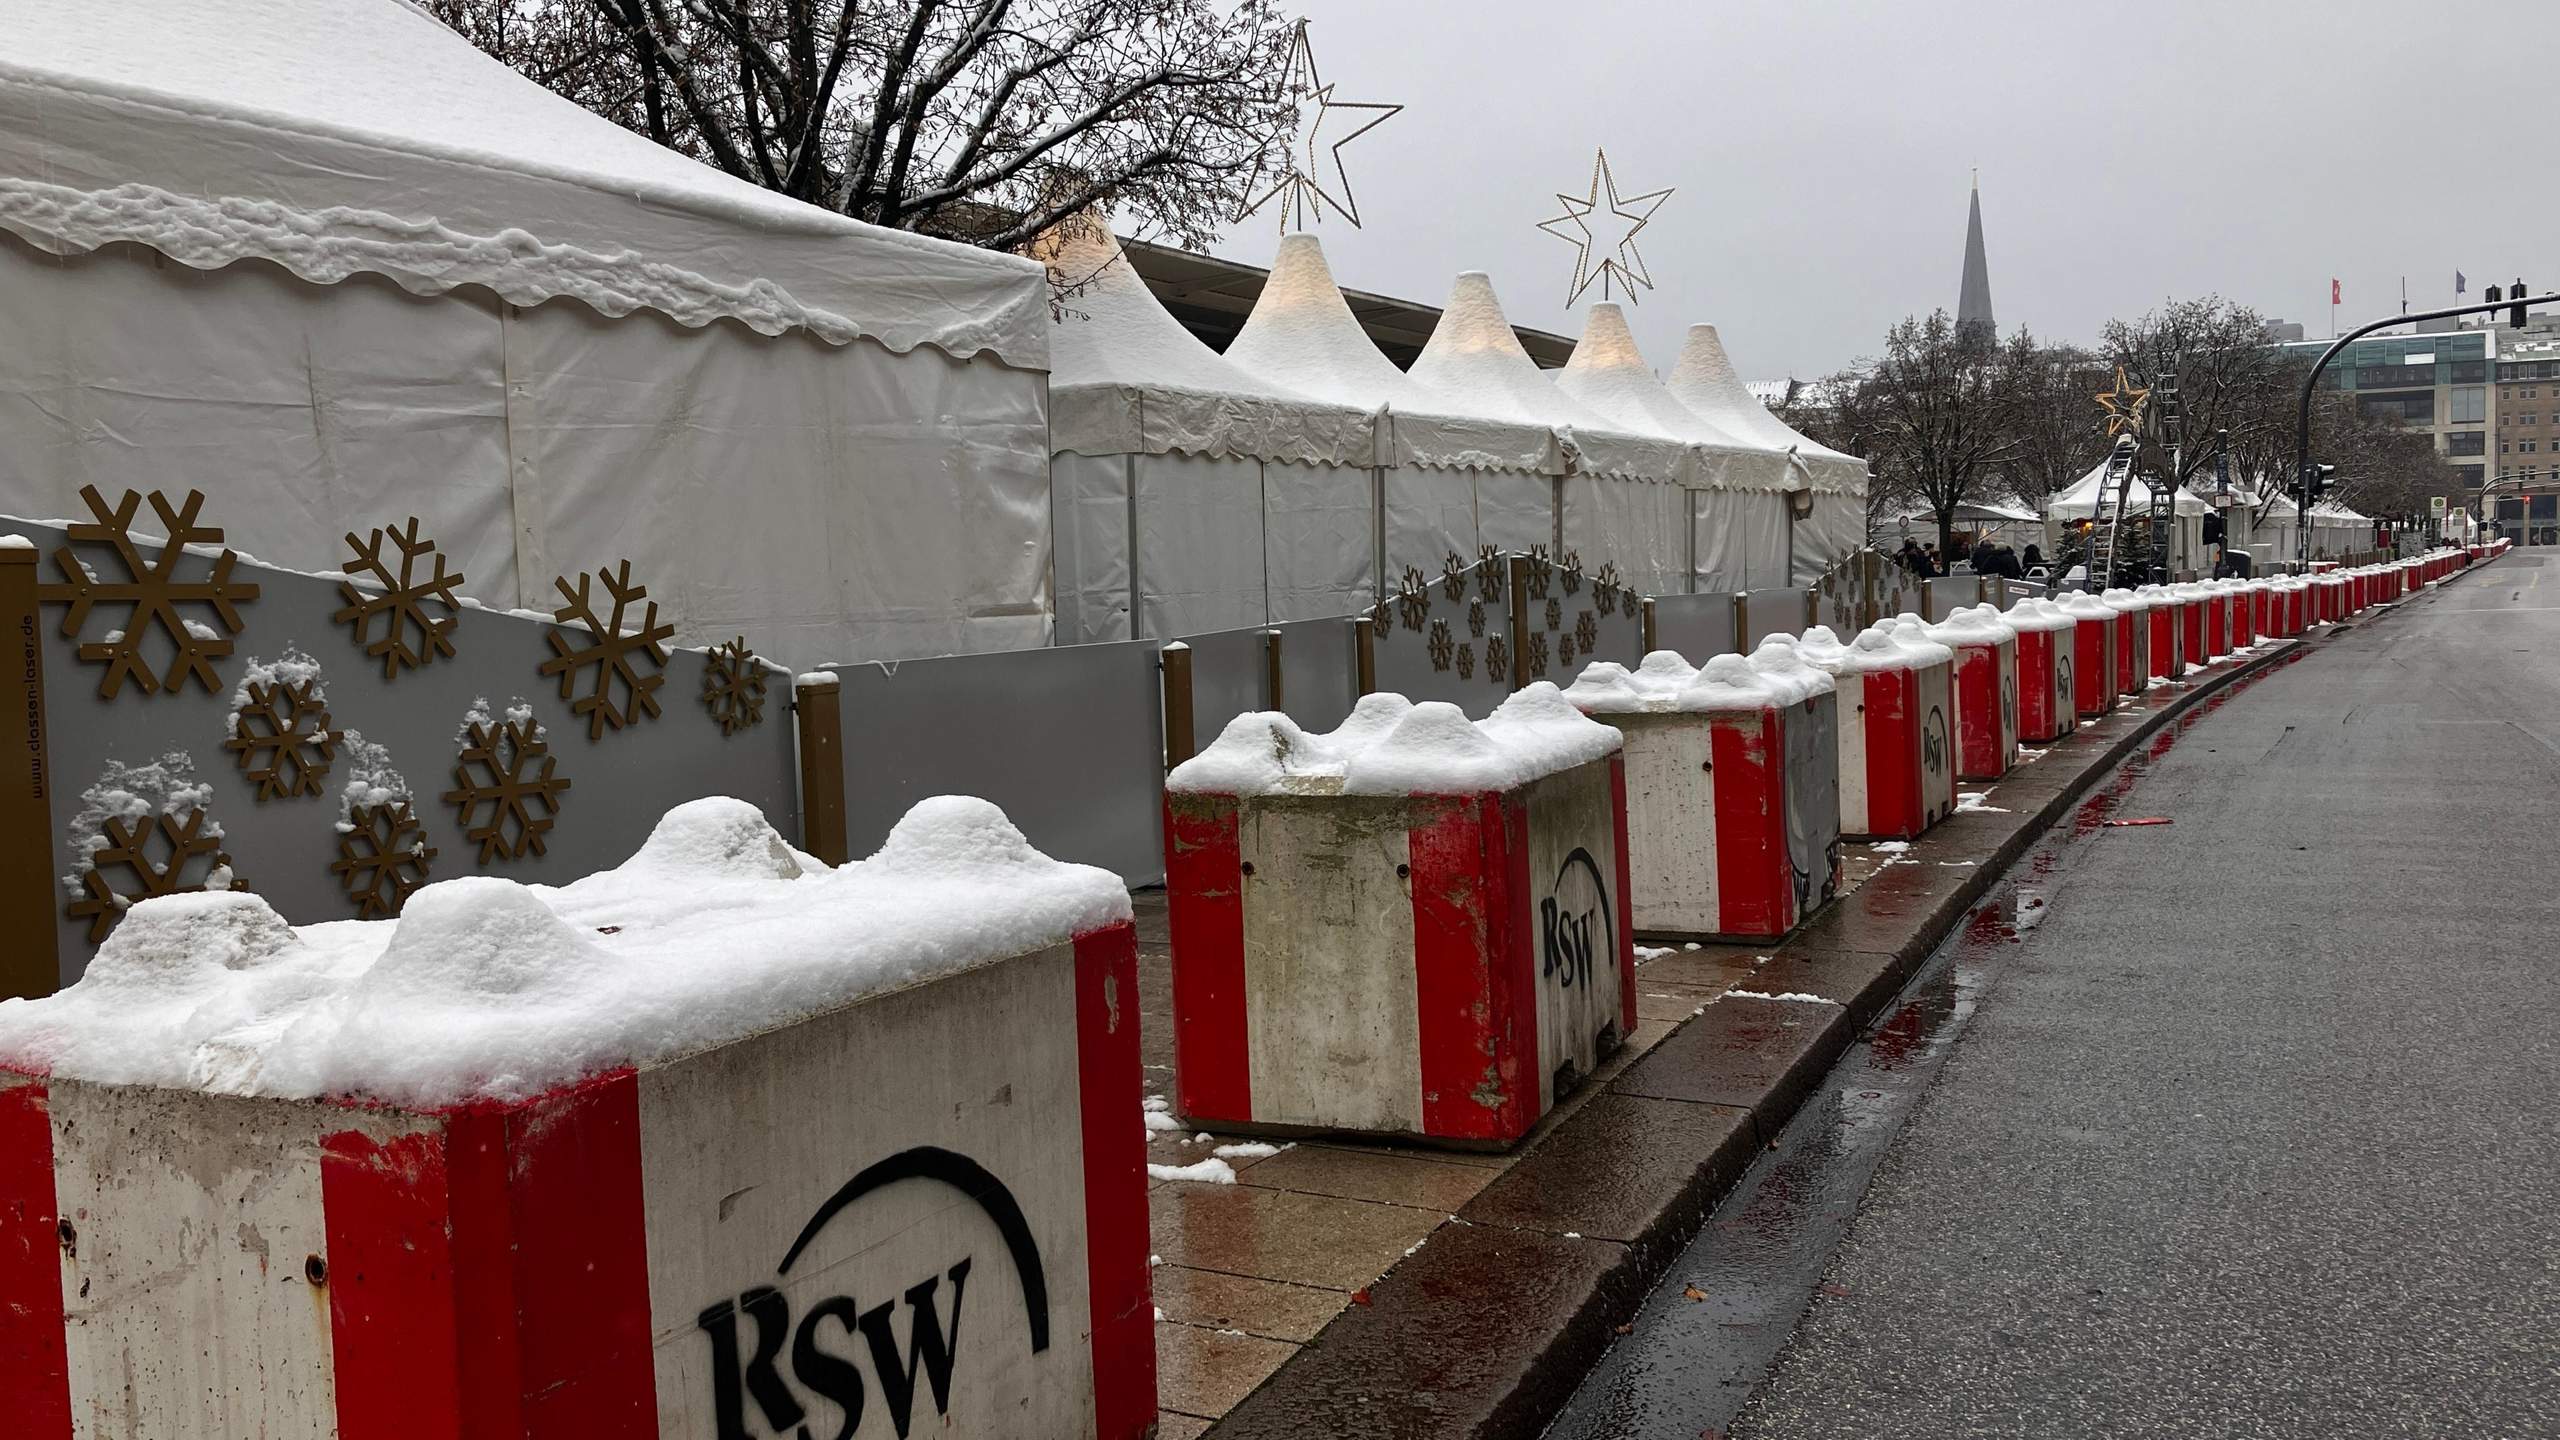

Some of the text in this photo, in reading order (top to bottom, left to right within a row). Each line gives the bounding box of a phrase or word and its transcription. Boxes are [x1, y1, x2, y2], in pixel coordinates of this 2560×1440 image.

[1923, 726, 1942, 777] RSW
[1540, 895, 1595, 991] RSW
[698, 1254, 972, 1440] RSW
